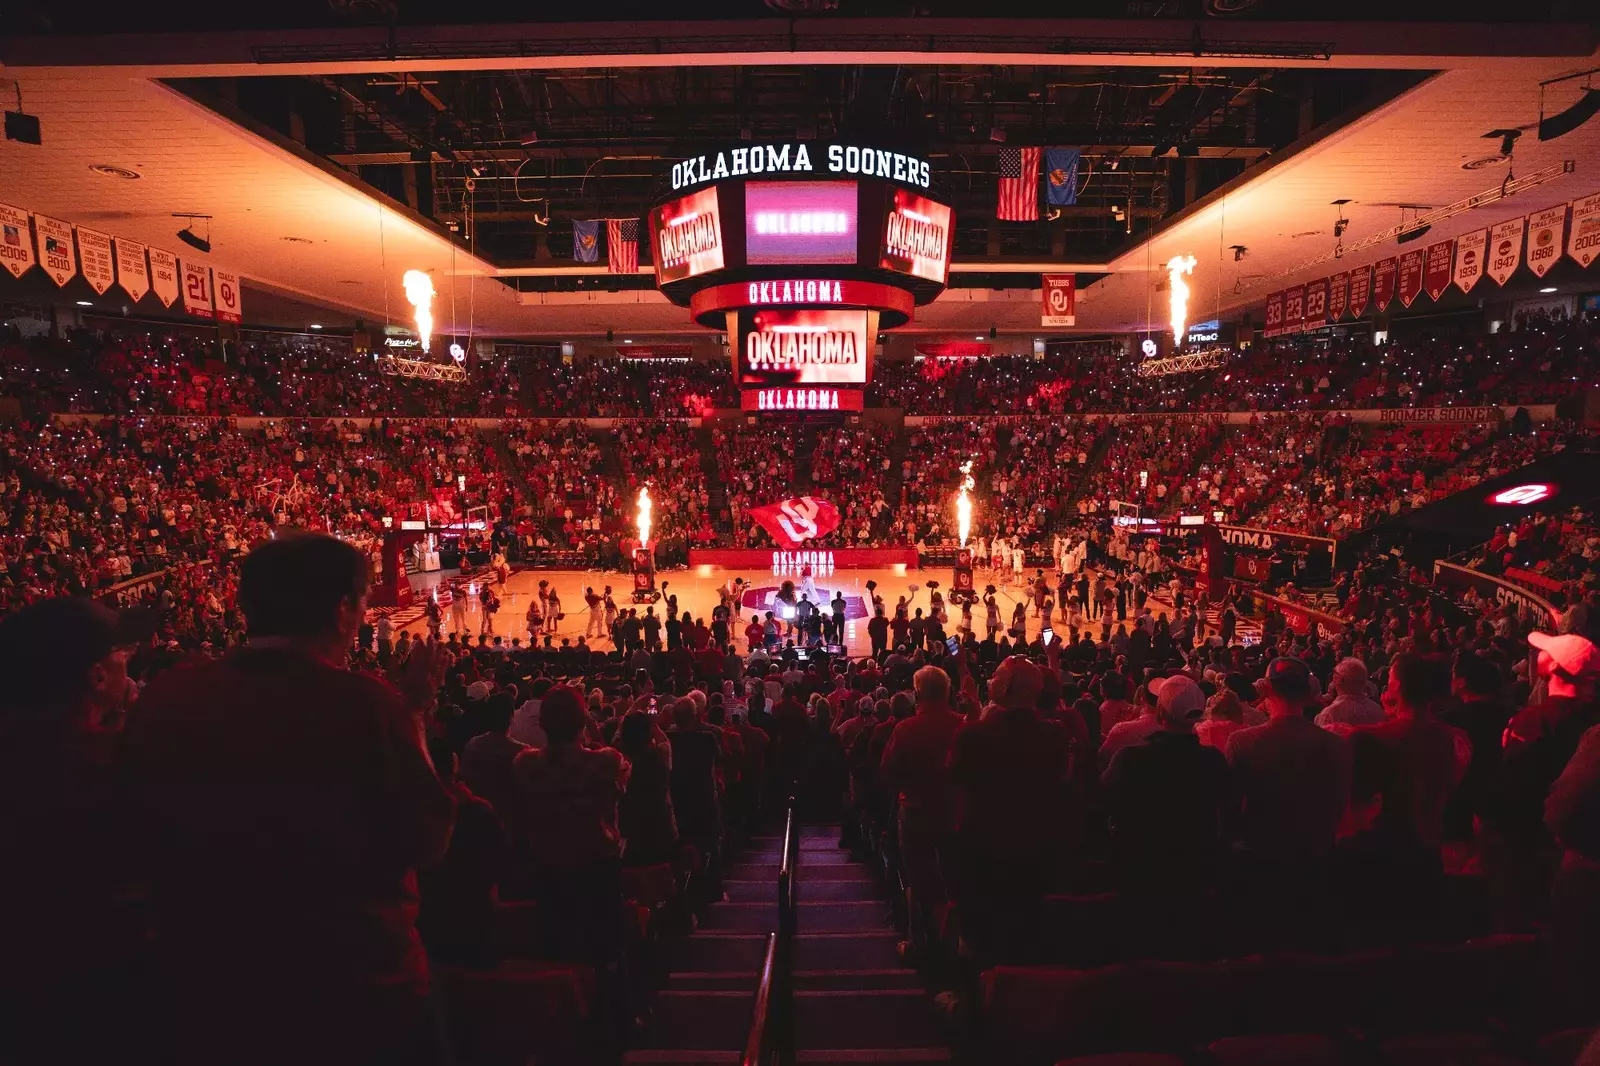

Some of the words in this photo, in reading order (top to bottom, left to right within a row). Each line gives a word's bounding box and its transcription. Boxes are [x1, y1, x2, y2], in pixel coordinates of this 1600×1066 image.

[672, 144, 812, 190] OKLAHOMA
[828, 145, 930, 188] SOONERS
[659, 212, 717, 262] OKLAHOMA
[887, 211, 943, 261] OKLAHOMA
[0, 244, 28, 262] 2009
[47, 255, 71, 271] 2010
[1493, 255, 1516, 271] 1947
[1530, 245, 1554, 262] 1988
[1459, 265, 1478, 279] 1939
[187, 273, 209, 302] 21
[220, 283, 236, 308] OU
[749, 280, 842, 304] OKLAHOMA
[1050, 289, 1068, 312] OU
[1286, 297, 1303, 321] 23
[1307, 291, 1326, 317] 23
[1267, 303, 1282, 325] 33
[449, 343, 465, 362] OU
[747, 331, 857, 364] OKLAHOMA
[1142, 339, 1157, 357] OU
[758, 390, 839, 410] OKLAHOMA
[1379, 408, 1435, 421] BOOMER
[1495, 484, 1548, 504] OU
[773, 551, 834, 565] OKLAHOMA
